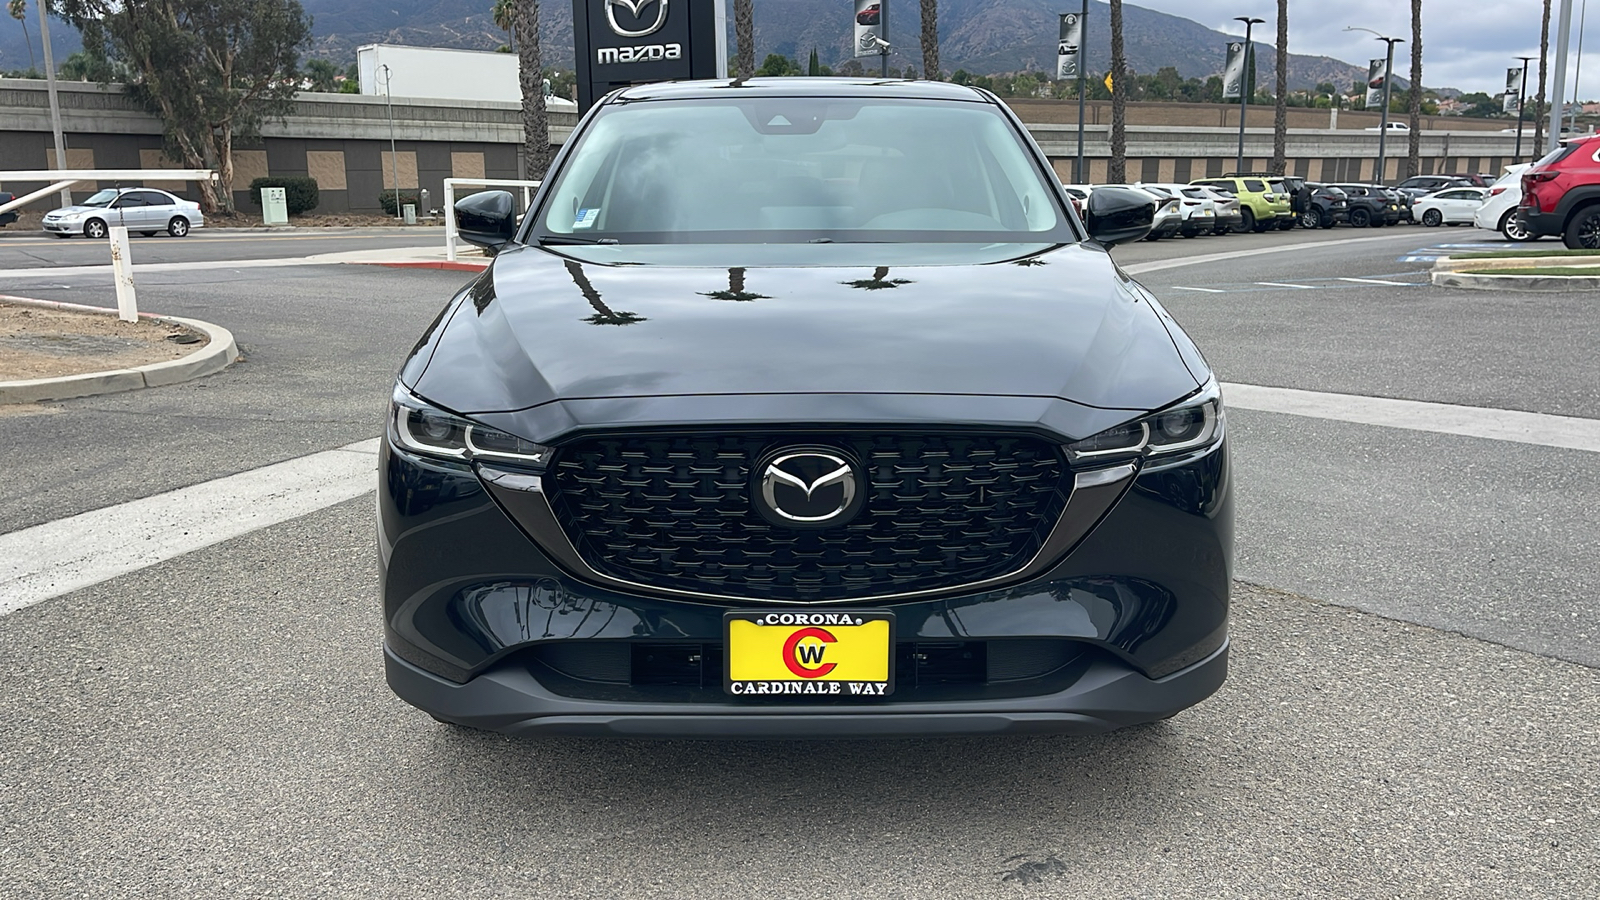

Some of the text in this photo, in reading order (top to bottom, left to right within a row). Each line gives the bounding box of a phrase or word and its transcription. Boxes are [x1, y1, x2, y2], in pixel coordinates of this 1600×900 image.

[766, 613, 854, 625] CORONA
[730, 682, 888, 695] CARDINALE WAY
